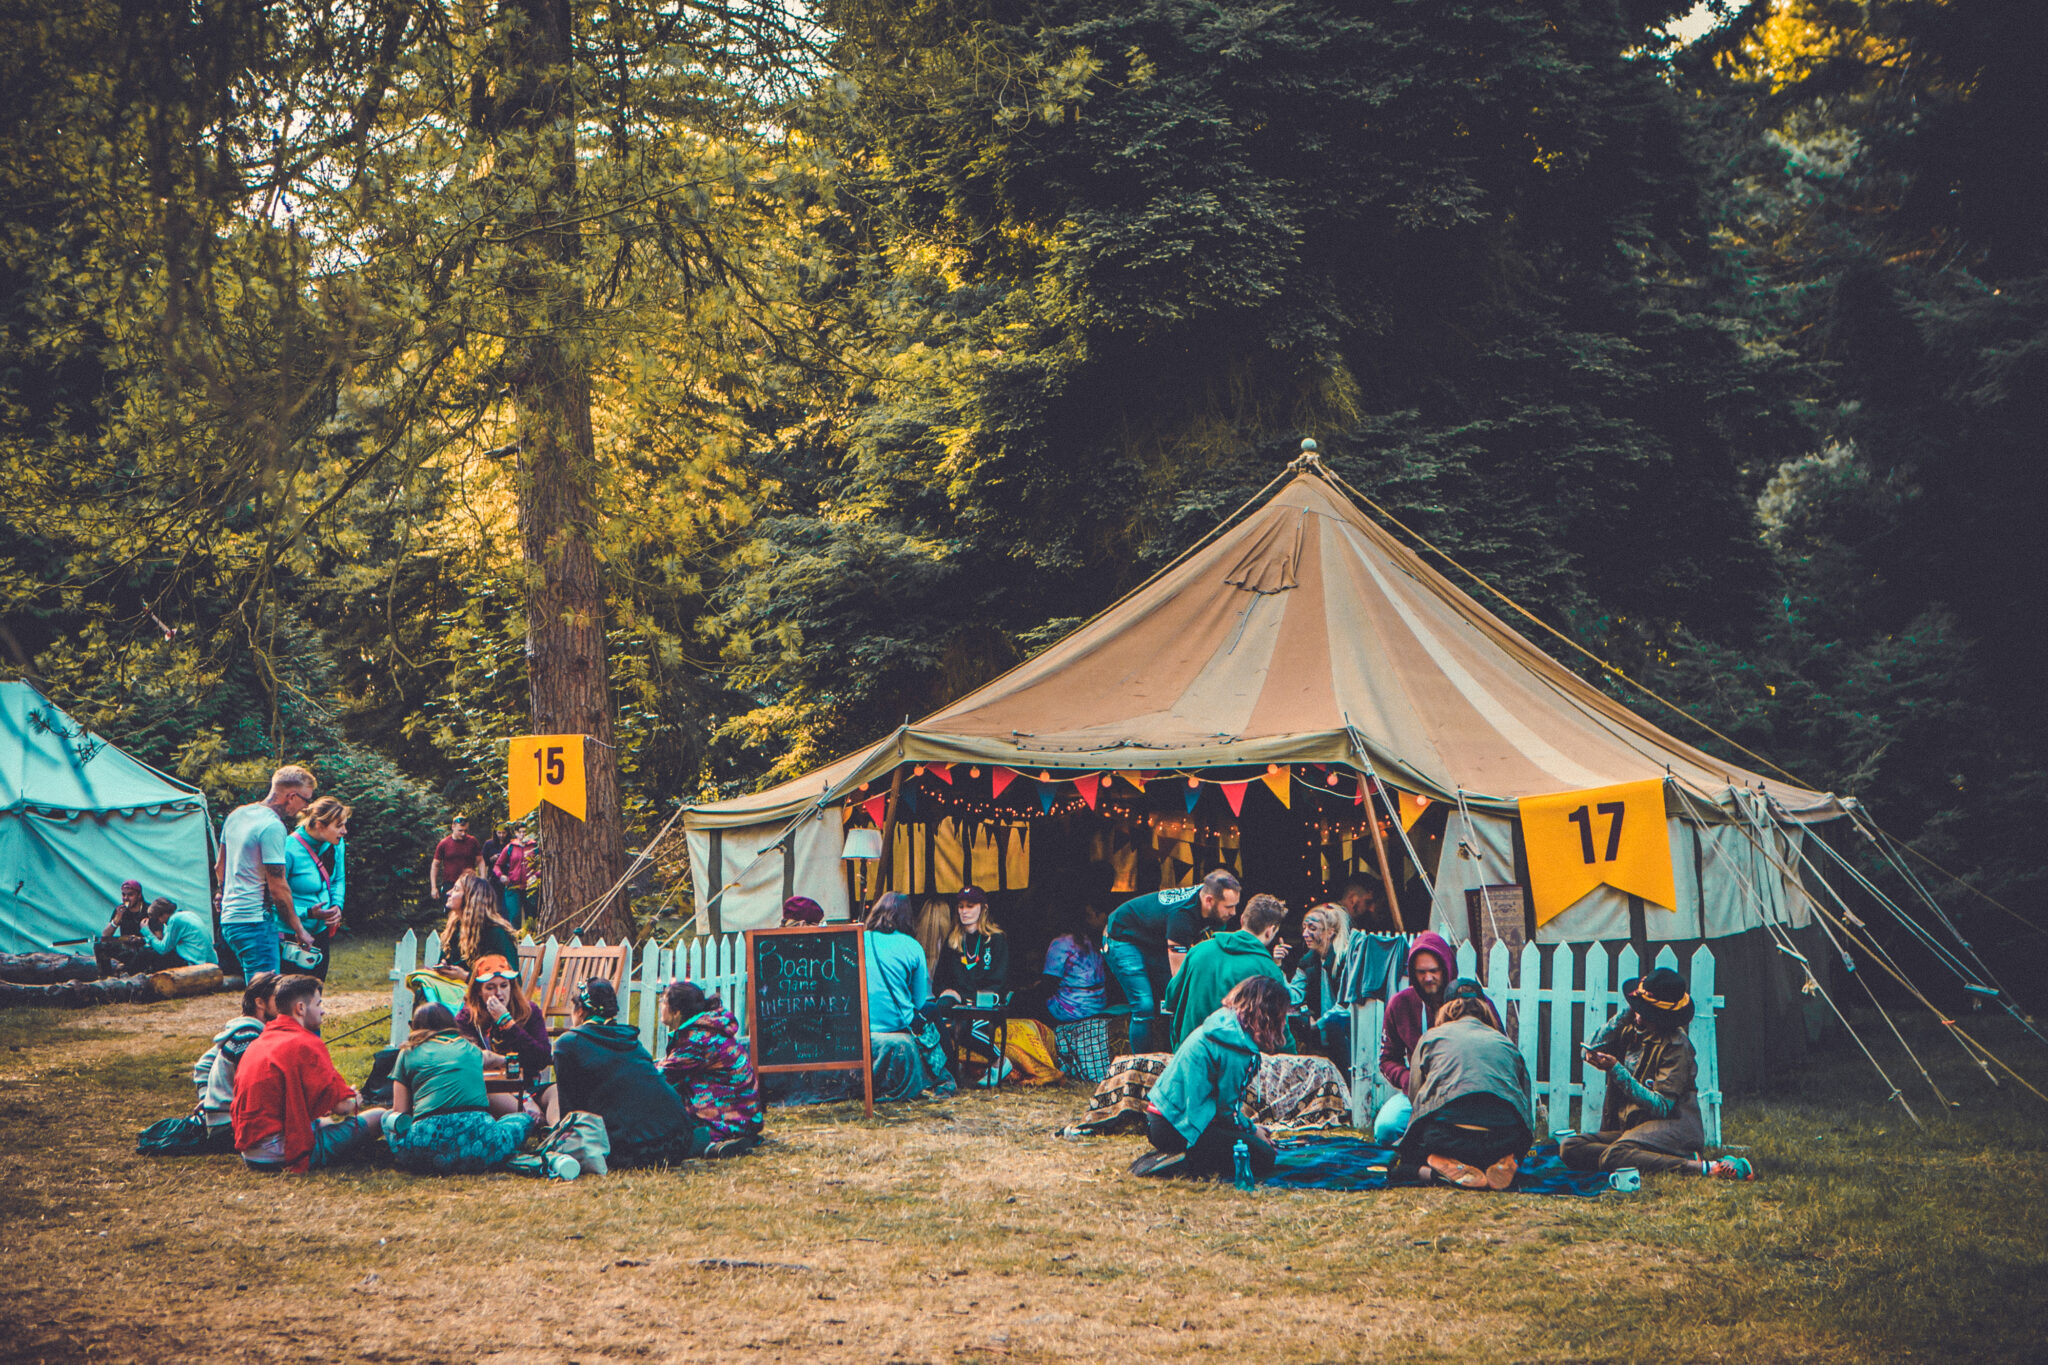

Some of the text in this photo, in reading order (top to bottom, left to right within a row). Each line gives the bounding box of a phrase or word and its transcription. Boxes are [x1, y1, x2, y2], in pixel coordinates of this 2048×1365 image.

[534, 747, 565, 786] 15
[1568, 801, 1625, 864] 17
[759, 940, 840, 982] Board
[760, 996, 851, 1017] INFIRMARY
